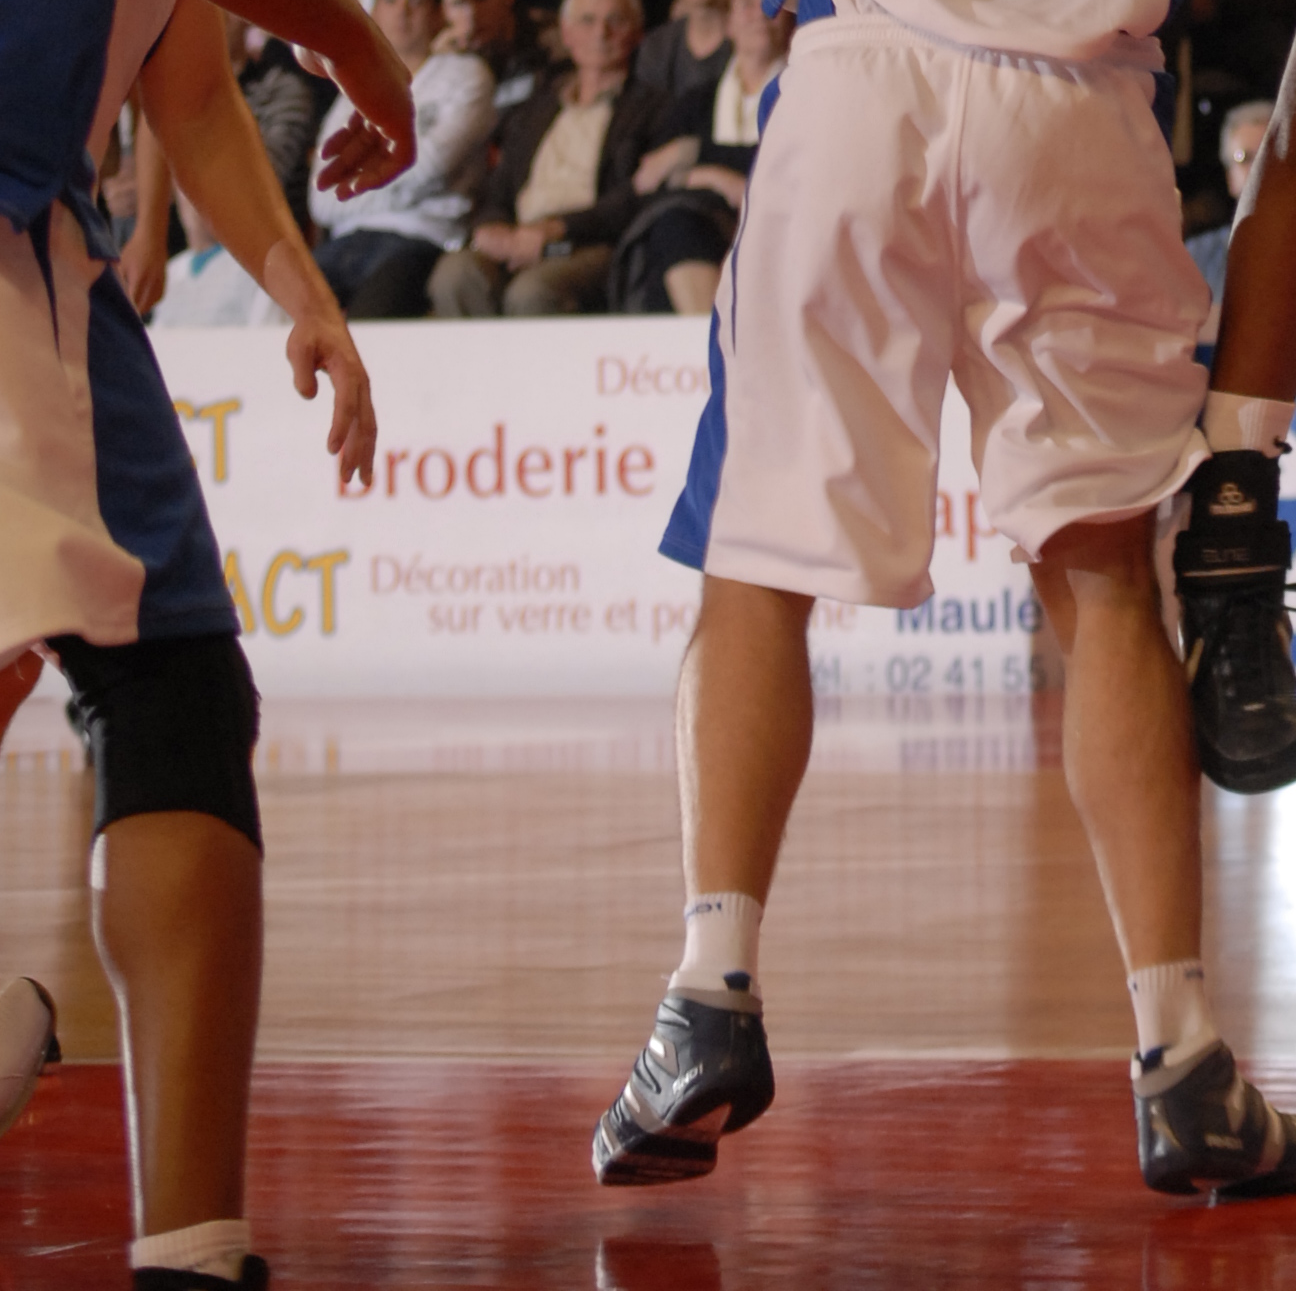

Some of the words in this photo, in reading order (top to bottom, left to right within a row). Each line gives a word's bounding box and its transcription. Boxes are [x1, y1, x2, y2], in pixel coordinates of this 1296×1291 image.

[370, 554, 580, 594] Décoration
[429, 601, 483, 633] sur
[499, 601, 592, 633] verre
[606, 597, 638, 633] et
